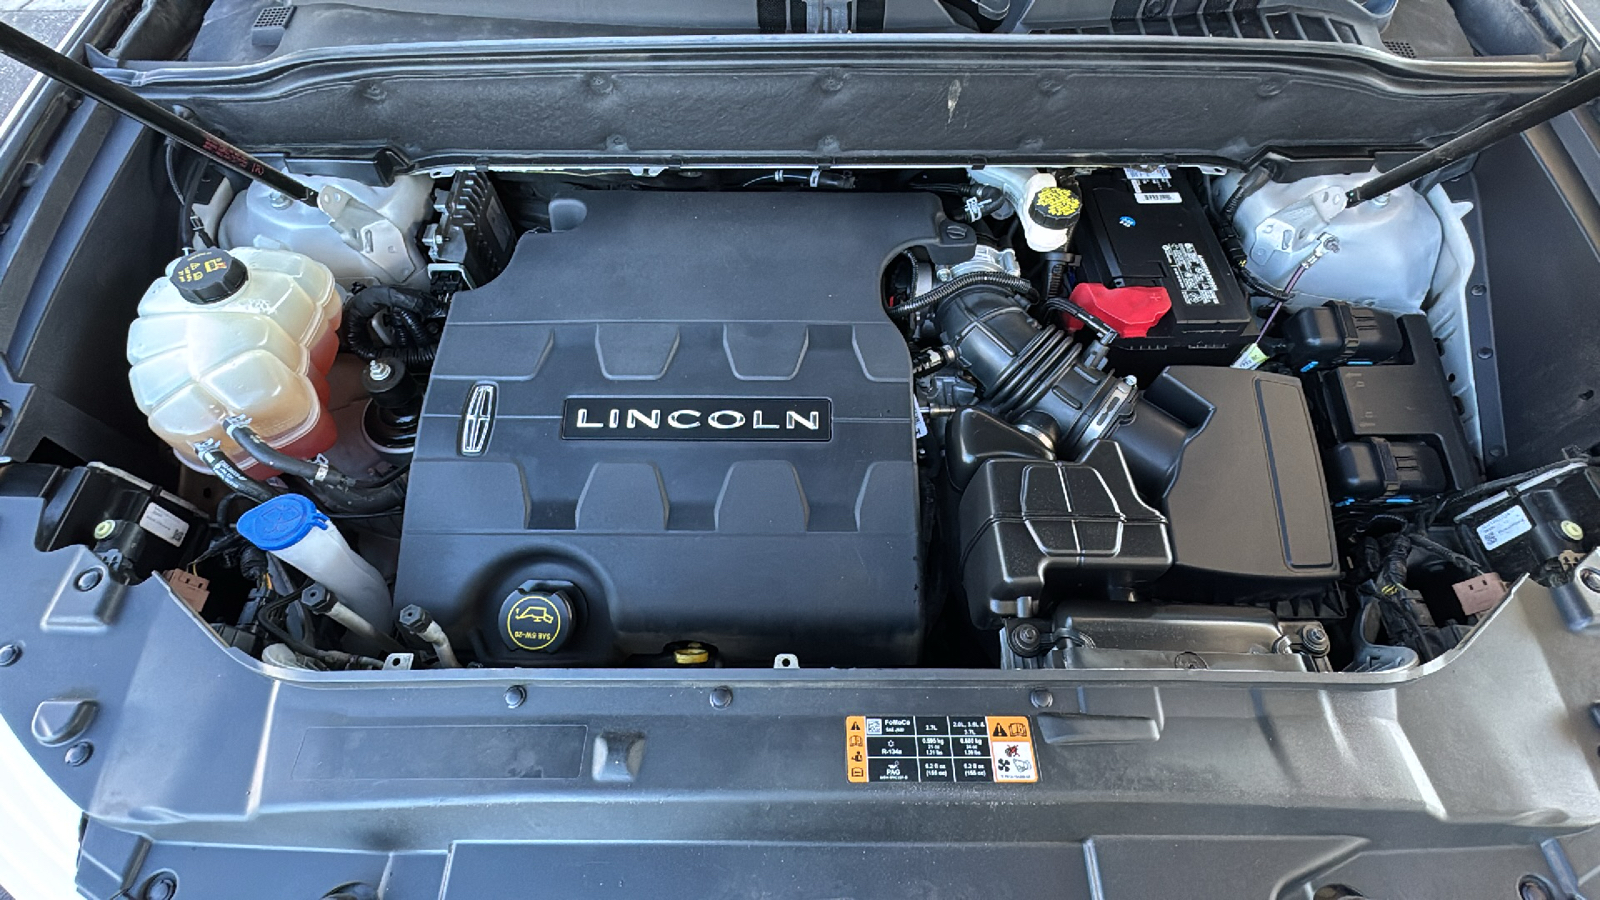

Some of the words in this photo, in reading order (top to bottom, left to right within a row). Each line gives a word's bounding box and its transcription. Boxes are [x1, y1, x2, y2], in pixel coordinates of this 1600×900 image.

[576, 408, 819, 430] LINCOLN
[538, 632, 551, 640] SAE
[886, 768, 901, 776] PAG
